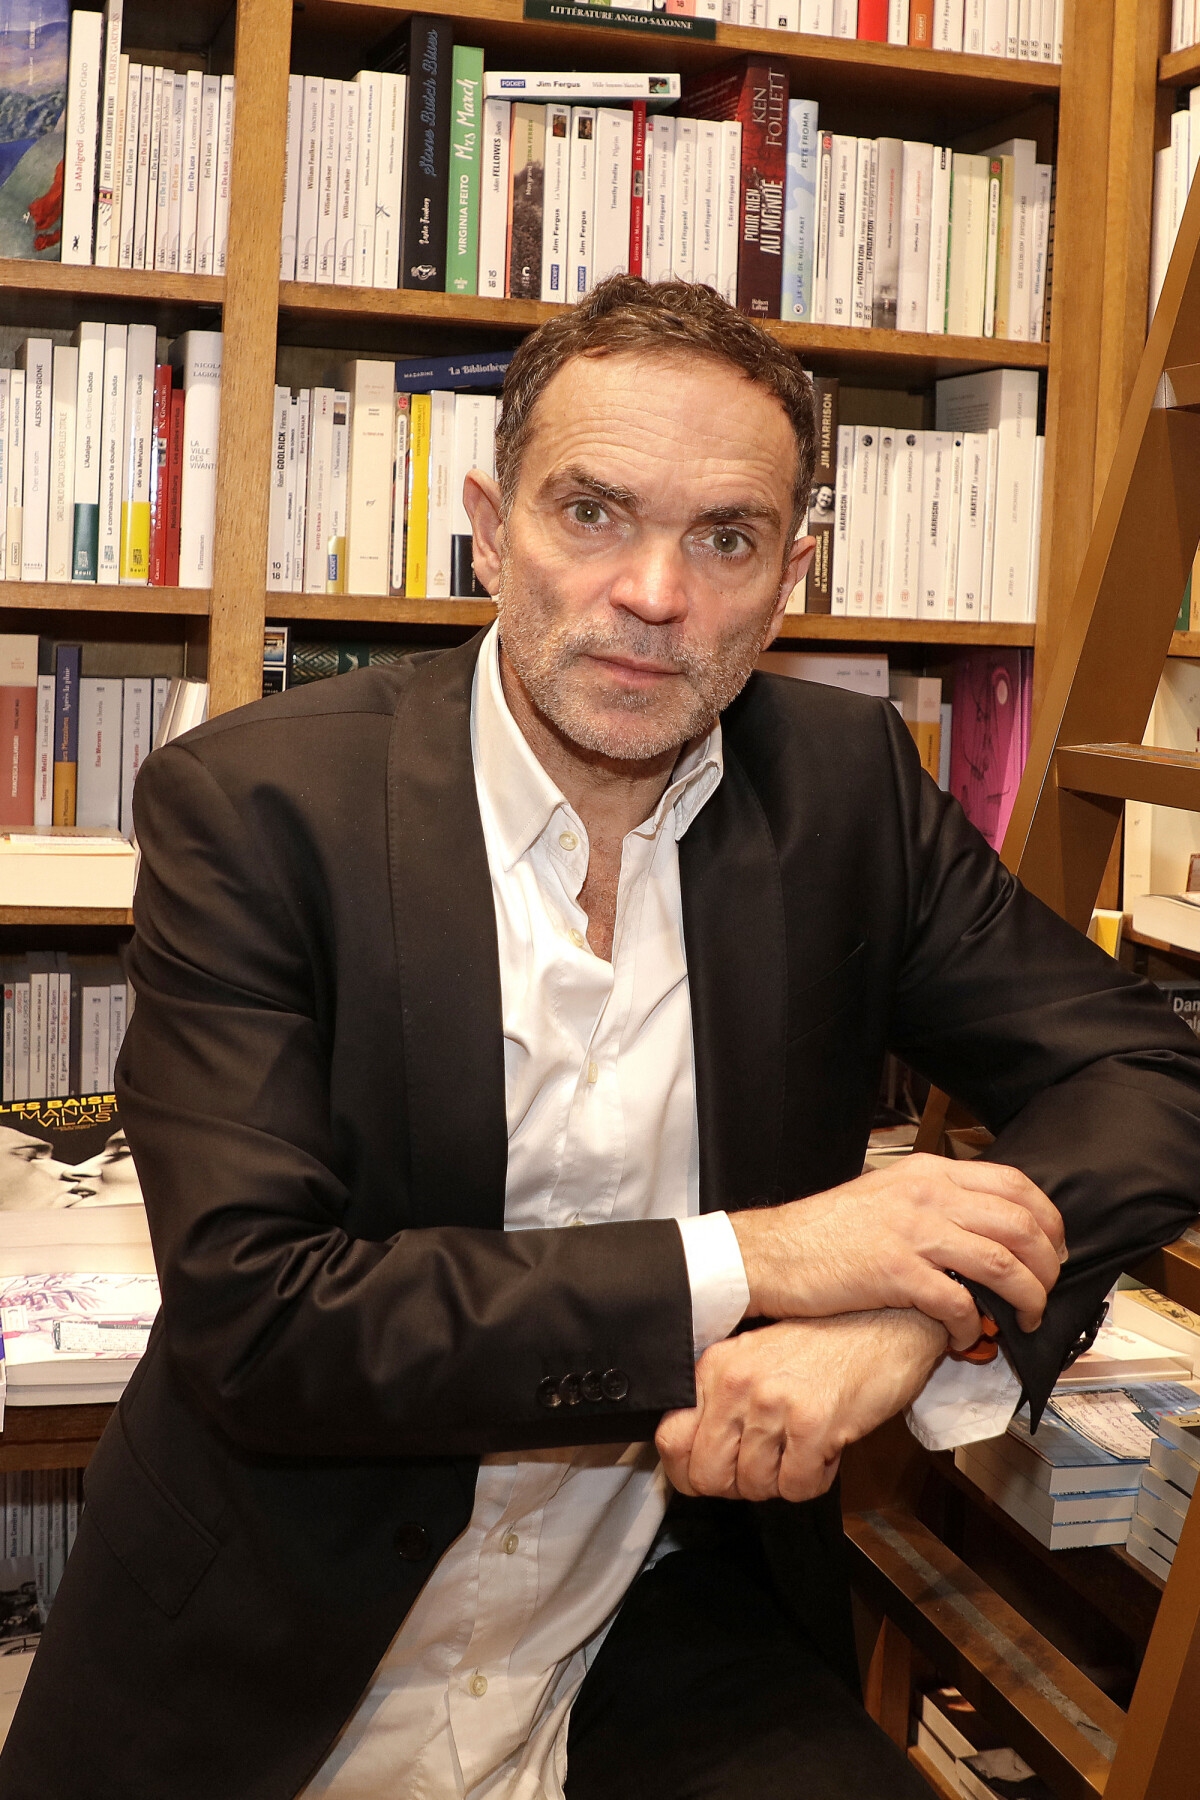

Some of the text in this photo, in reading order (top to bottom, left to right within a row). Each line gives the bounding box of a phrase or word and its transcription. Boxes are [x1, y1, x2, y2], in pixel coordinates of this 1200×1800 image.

[550, 4, 693, 30] LITTÉRATURE ANGLO-SAXONNE
[418, 29, 439, 177] Stone Butch Blues
[752, 87, 768, 123] KEN
[765, 67, 785, 147] FOLLETT
[74, 62, 88, 192] La Maligredi Gioacchino Criaco
[453, 78, 478, 161] Mrs March
[141, 134, 149, 147] Luca
[126, 148, 135, 161] Luca
[152, 148, 160, 160] Luca
[205, 158, 211, 166] De
[151, 170, 159, 181] Erri
[172, 164, 180, 200] Erri De Luca
[188, 171, 194, 180] De
[220, 161, 230, 198] Erri De Luca
[160, 185, 166, 193] De
[342, 195, 352, 219] William
[457, 174, 469, 255] VIRGINIA FEITO
[743, 188, 760, 242] POUR RIEN
[759, 179, 784, 255] AU MONDE
[448, 367, 461, 376] La
[821, 392, 833, 468] JIM HARRISON
[277, 432, 285, 470] GOOLRICK
[109, 471, 114, 482] de
[170, 407, 181, 529] Natalia Ginzburg Les petites vertus
[137, 480, 142, 488] de
[106, 482, 116, 526] connaissance
[814, 577, 822, 587] LA
[820, 583, 828, 593] DE
[63, 666, 71, 684] pluie
[62, 692, 70, 712] Après
[0, 1094, 116, 1113] LES BAISE
[38, 1112, 111, 1127] VILAS
